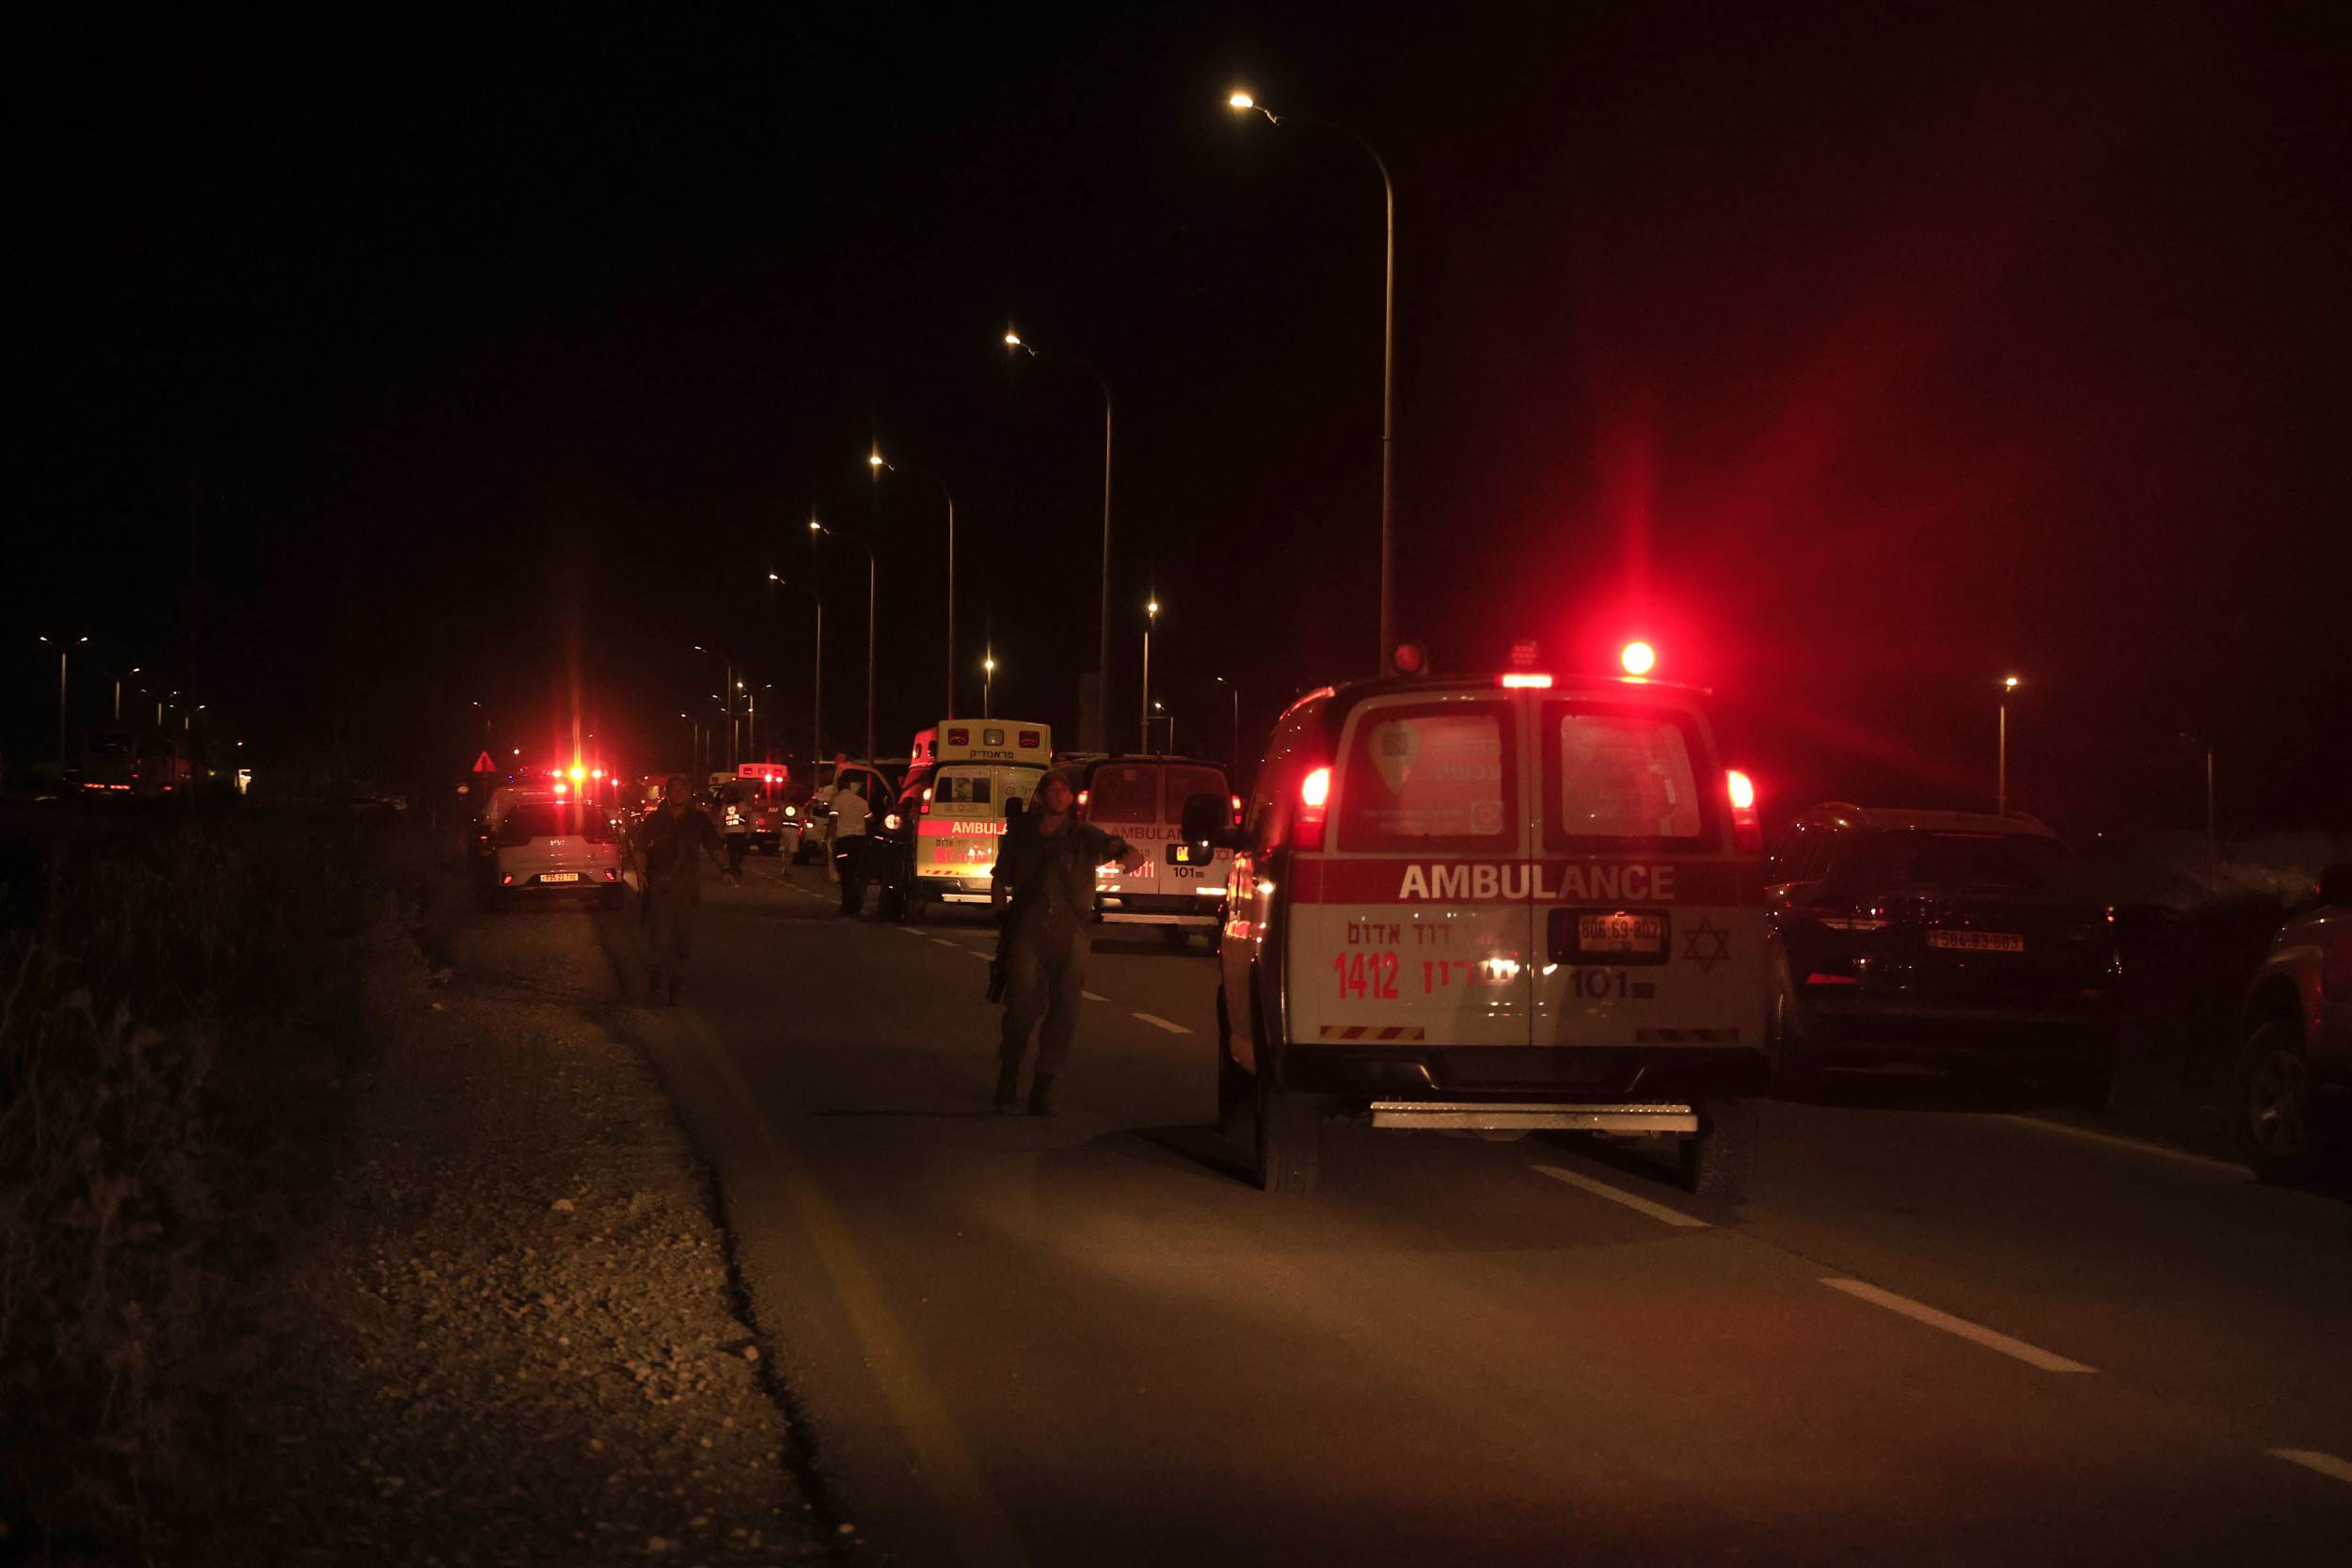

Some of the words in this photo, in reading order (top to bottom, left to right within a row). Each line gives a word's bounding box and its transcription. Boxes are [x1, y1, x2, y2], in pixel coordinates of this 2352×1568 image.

[969, 750, 1014, 759] פראמדיק
[951, 821, 1008, 835] AMBULA
[1111, 827, 1184, 840] AMBULAN
[1129, 861, 1155, 879] 011
[1173, 867, 1196, 878] 101
[1399, 864, 1675, 899] AMBULANCE
[1347, 922, 1401, 944] אדום
[1412, 924, 1452, 944] דוד
[1334, 951, 1399, 999] 1412
[1569, 970, 1627, 999] 101
